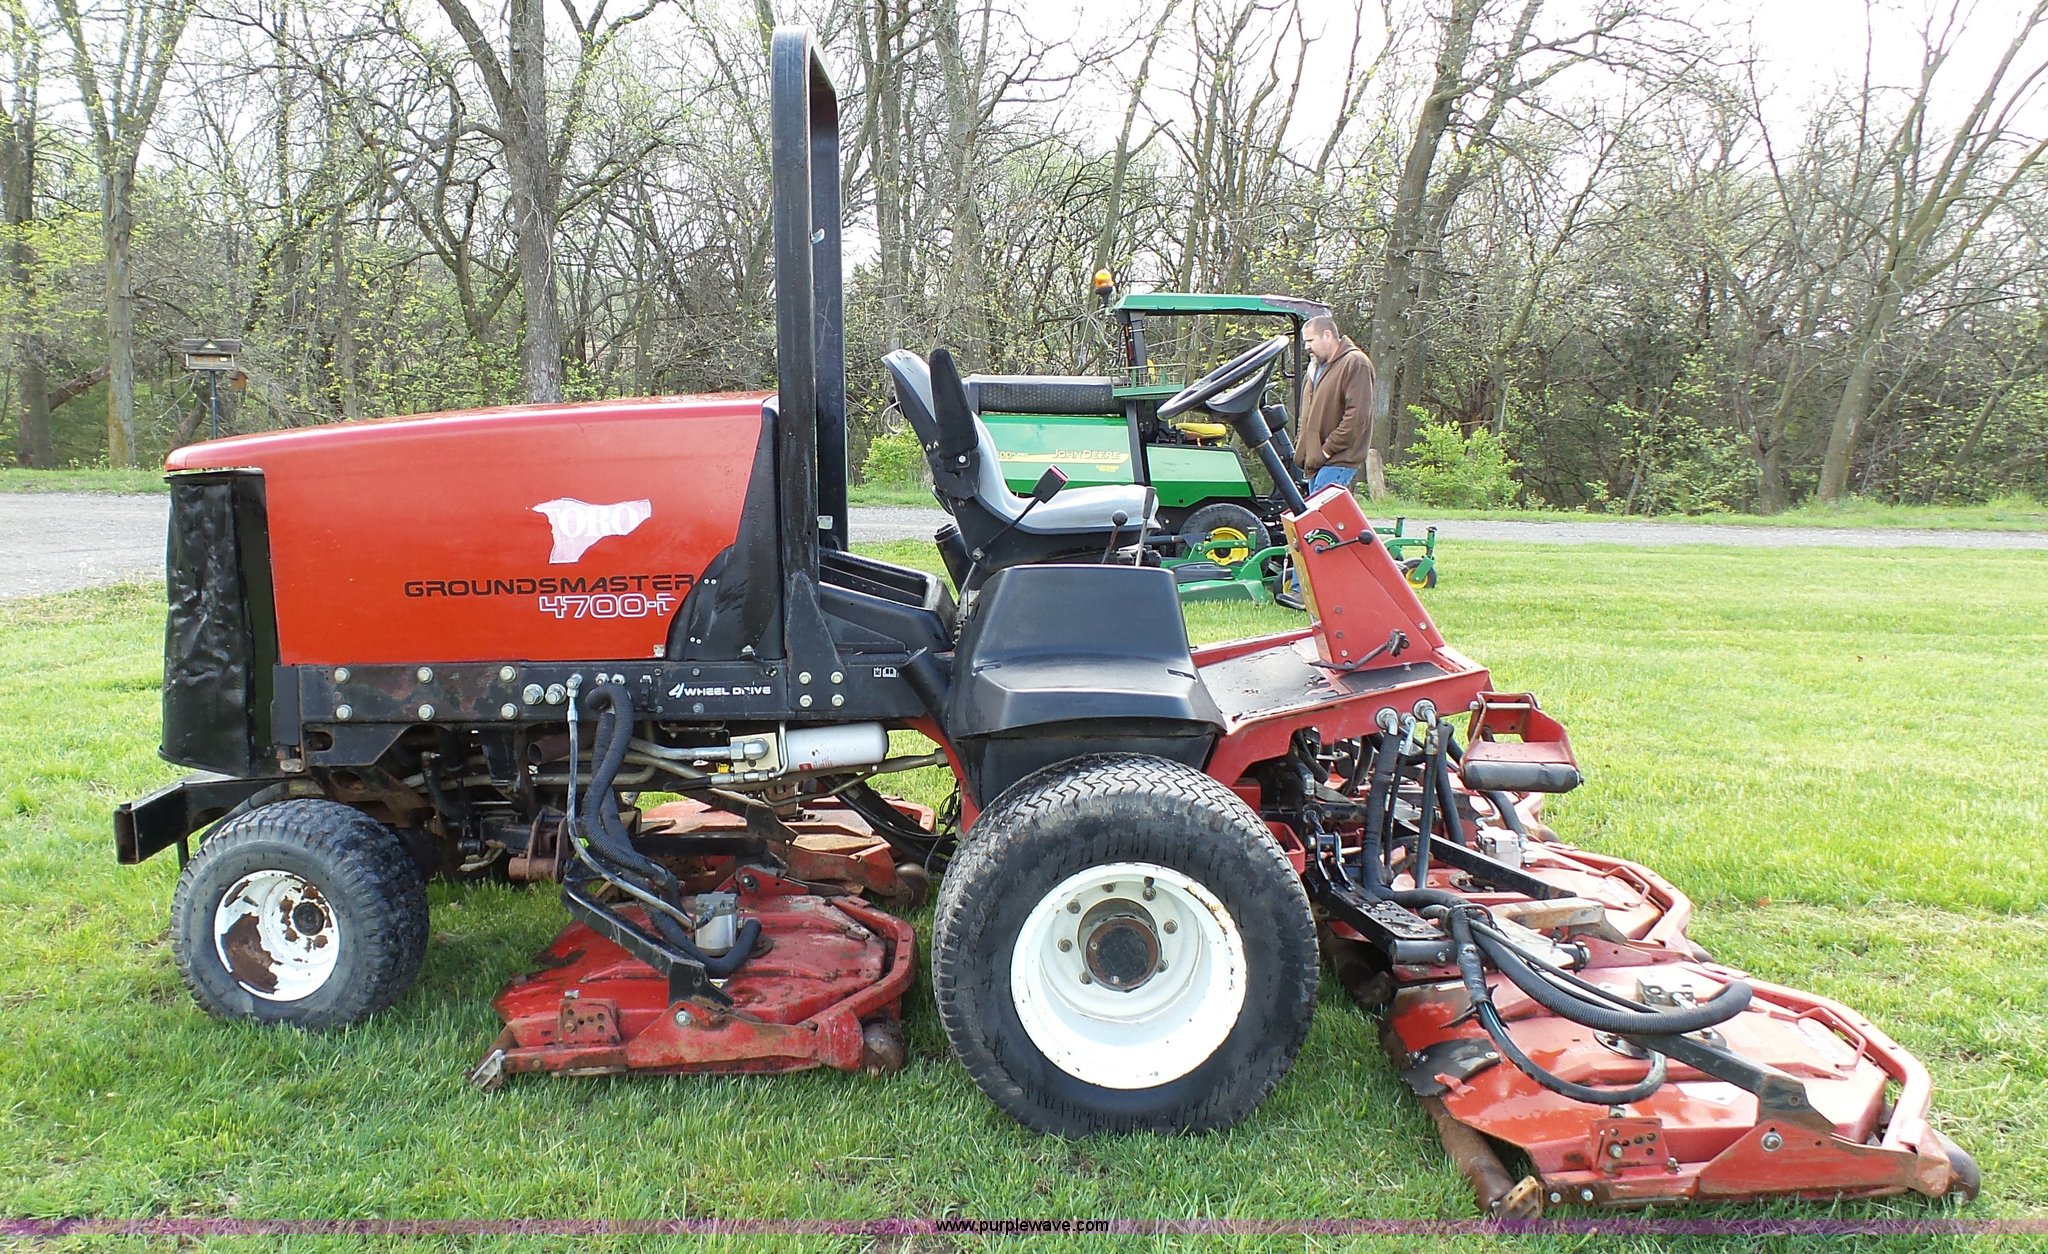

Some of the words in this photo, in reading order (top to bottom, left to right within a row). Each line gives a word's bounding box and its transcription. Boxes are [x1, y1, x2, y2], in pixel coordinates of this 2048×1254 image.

[1052, 449, 1081, 460] JOHN
[1083, 449, 1120, 460] DEERE
[403, 573, 695, 598] GROUNDSMASTER
[668, 682, 685, 699] 4
[684, 687, 731, 697] WHEEL
